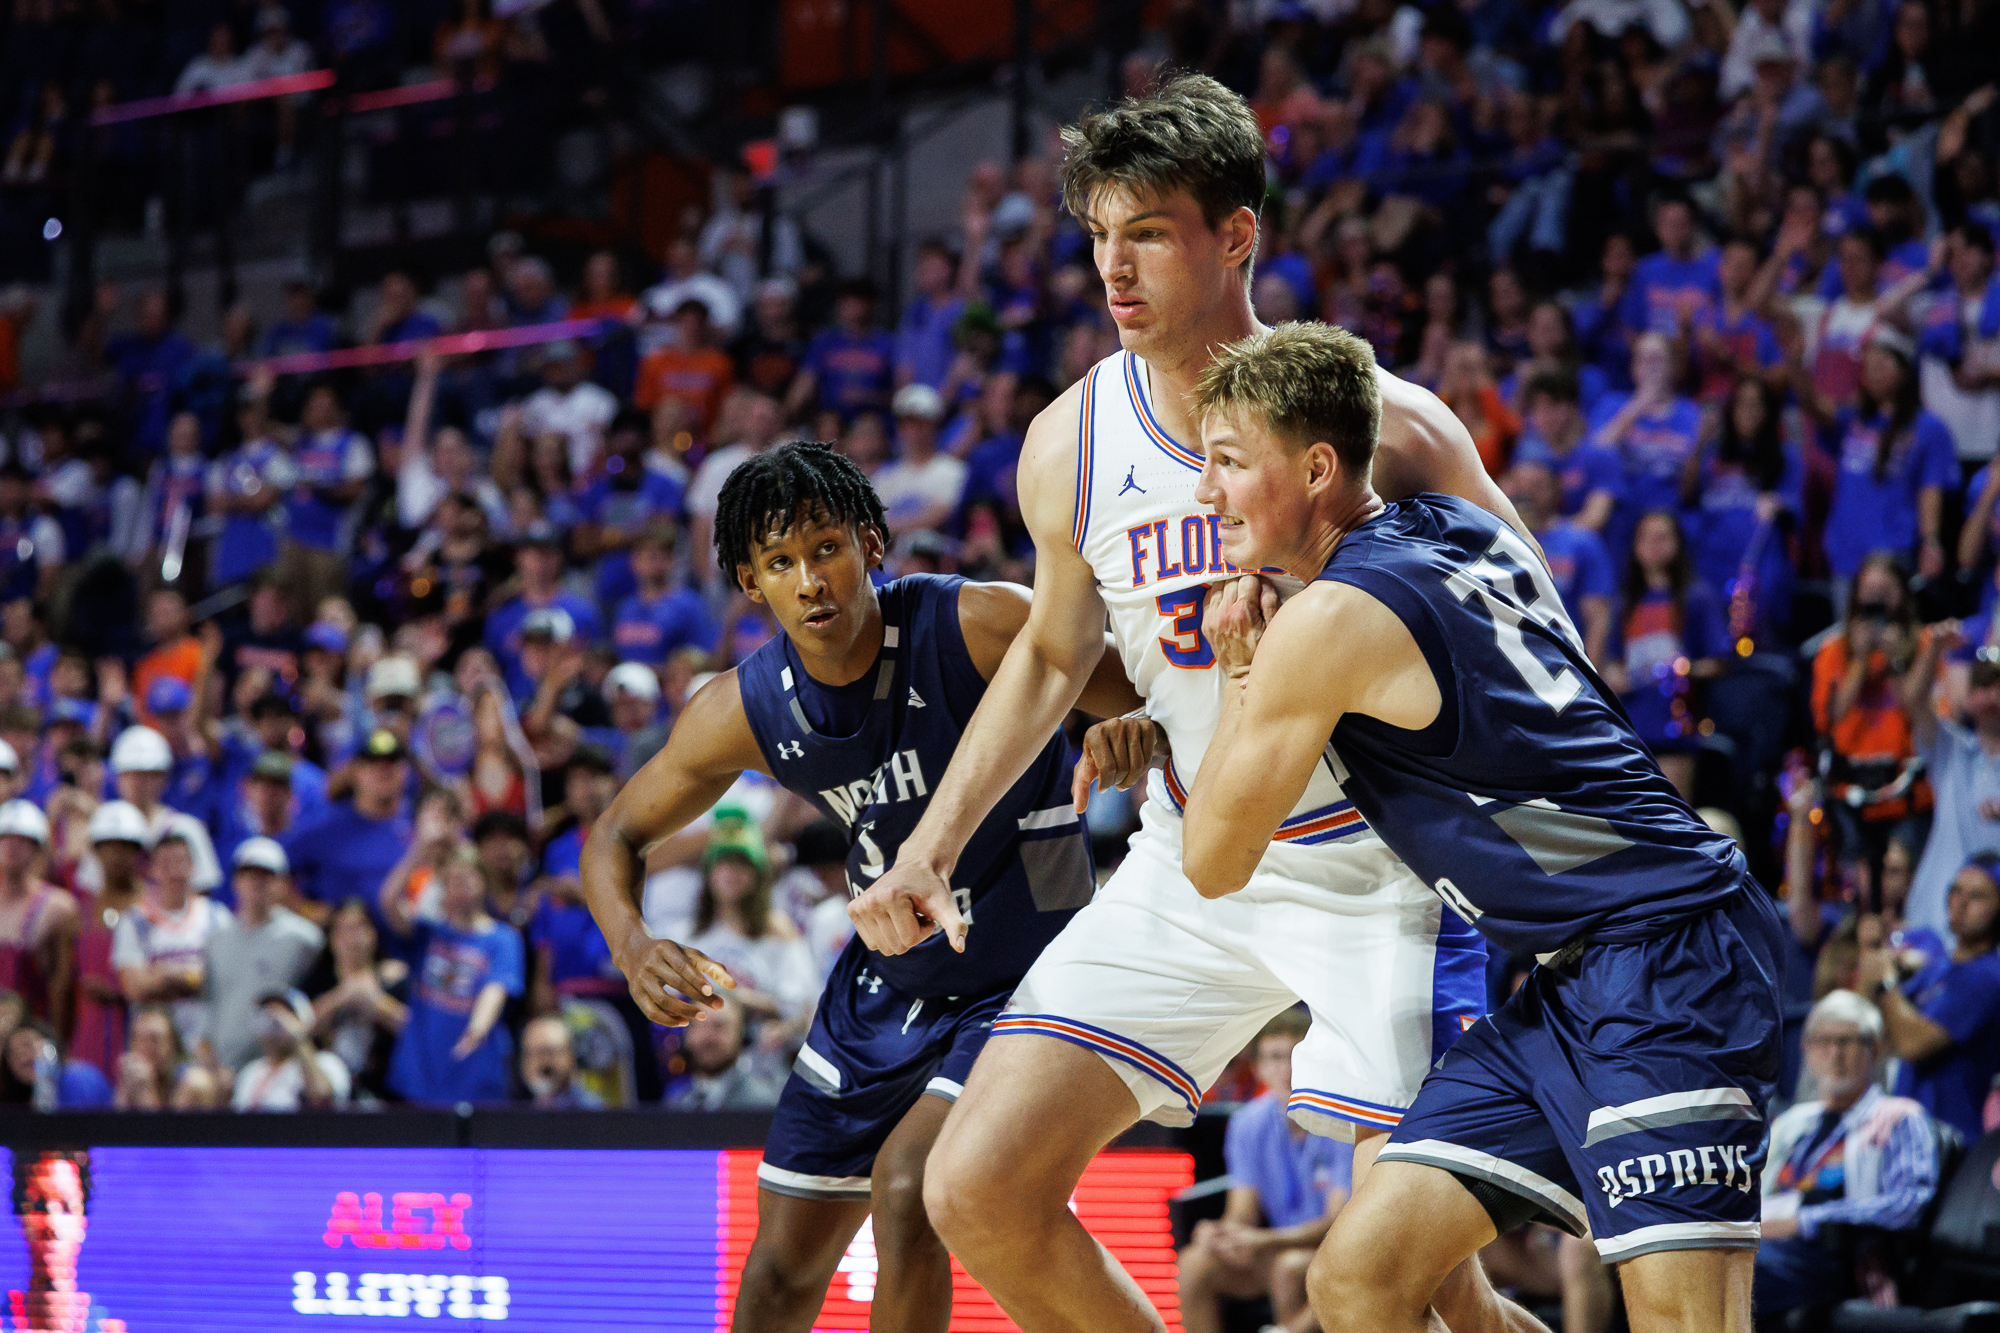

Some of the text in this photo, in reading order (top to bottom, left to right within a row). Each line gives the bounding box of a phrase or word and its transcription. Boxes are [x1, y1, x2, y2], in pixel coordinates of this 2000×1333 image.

[1596, 1145, 1752, 1209] OSPREYS
[322, 1191, 473, 1250] ALEX
[291, 1270, 512, 1320] LLOYD
